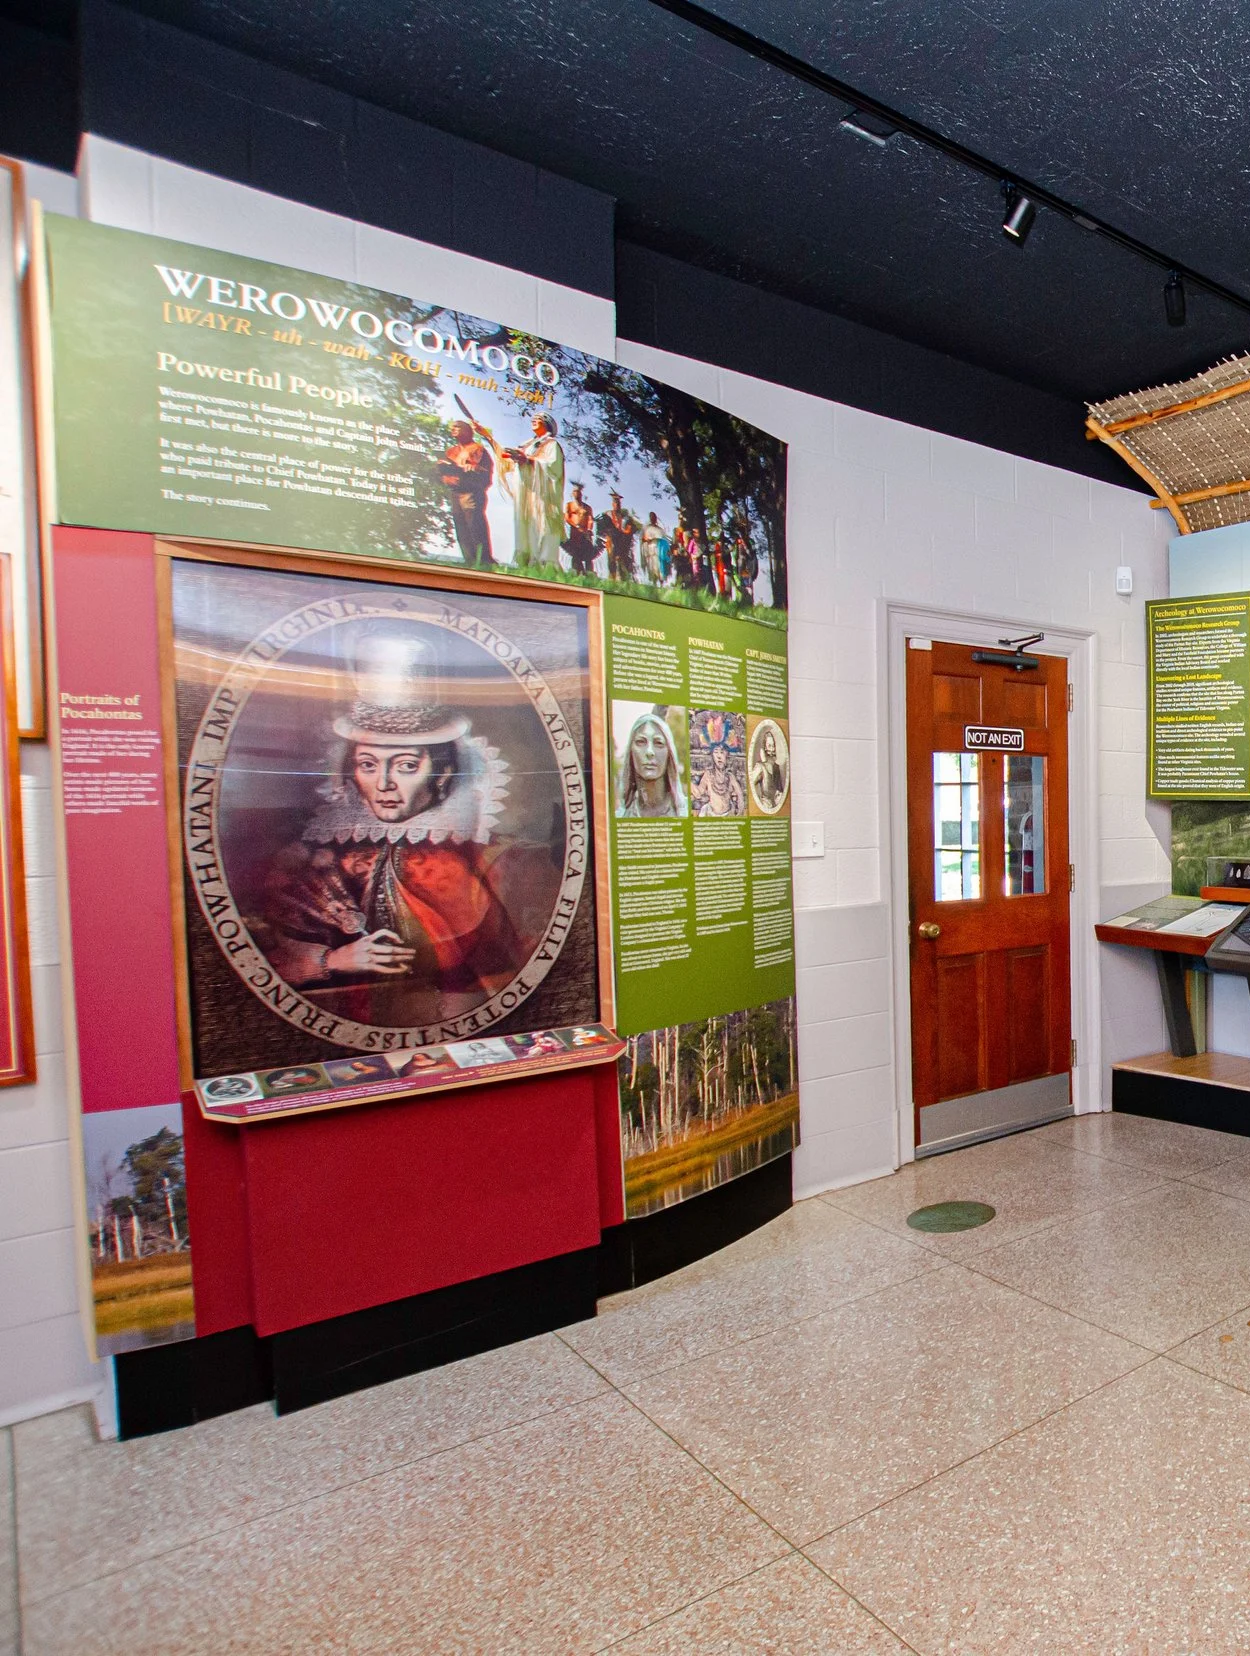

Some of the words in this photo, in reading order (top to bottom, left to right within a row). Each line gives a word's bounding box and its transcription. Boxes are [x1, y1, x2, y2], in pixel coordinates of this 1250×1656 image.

[153, 264, 559, 386] WEROWOCOMOCO
[157, 351, 282, 392] Powerful
[288, 374, 373, 409] People
[272, 328, 303, 346] uh
[322, 338, 370, 361] wah
[388, 352, 442, 378] KOH
[458, 372, 498, 393] muh
[158, 385, 247, 409] Werowocomoco
[250, 401, 258, 411] is
[262, 403, 306, 421] famously
[309, 411, 343, 426] known
[346, 419, 355, 428] as
[358, 420, 372, 431] the
[375, 424, 400, 435] place
[158, 400, 192, 413] where
[254, 414, 313, 432] Pocahontas
[316, 426, 333, 436] and
[337, 428, 373, 442] Captain
[376, 435, 397, 446] John
[400, 439, 425, 451] Smith
[160, 411, 181, 423] first
[211, 419, 229, 431] but
[232, 423, 259, 436] there
[262, 428, 270, 437] is
[273, 431, 299, 442] more
[301, 434, 312, 444] to
[315, 436, 330, 447] the
[160, 437, 169, 447] It
[195, 443, 217, 454] also
[220, 446, 237, 457] the
[240, 451, 275, 463] central
[278, 456, 305, 467] place
[308, 460, 318, 469] of
[321, 463, 351, 474] power
[354, 466, 367, 477] for
[369, 469, 384, 479] the
[387, 471, 413, 483] tribes
[160, 451, 184, 462] who
[187, 456, 211, 466] paid
[214, 458, 250, 472] tribute
[253, 464, 263, 474] to
[266, 466, 293, 478] Chief
[350, 478, 376, 491] Today
[379, 482, 386, 491] it
[388, 484, 396, 493] is
[398, 486, 414, 495] still
[160, 465, 175, 474] an
[176, 465, 231, 482] important
[235, 474, 262, 486] place
[265, 478, 280, 488] for
[283, 480, 331, 495] Powhatan
[335, 488, 387, 503] descendant
[160, 489, 184, 500] The
[185, 494, 214, 507] story
[1155, 609, 1187, 618] Archeology
[1196, 604, 1246, 614] Werowocomoco
[437, 606, 550, 700] MATOAKA
[612, 624, 665, 641] POCAHONTAS
[688, 637, 724, 651] POWHATAN
[759, 651, 771, 661] JOHN
[60, 692, 121, 705] Portraits
[125, 695, 140, 705] of
[61, 707, 143, 720] Pocahontas
[967, 731, 987, 744] NOT
[988, 733, 1001, 744] AN
[1002, 734, 1021, 745] EXIT
[561, 762, 586, 881] REBECCA
[536, 898, 577, 962] FILIA
